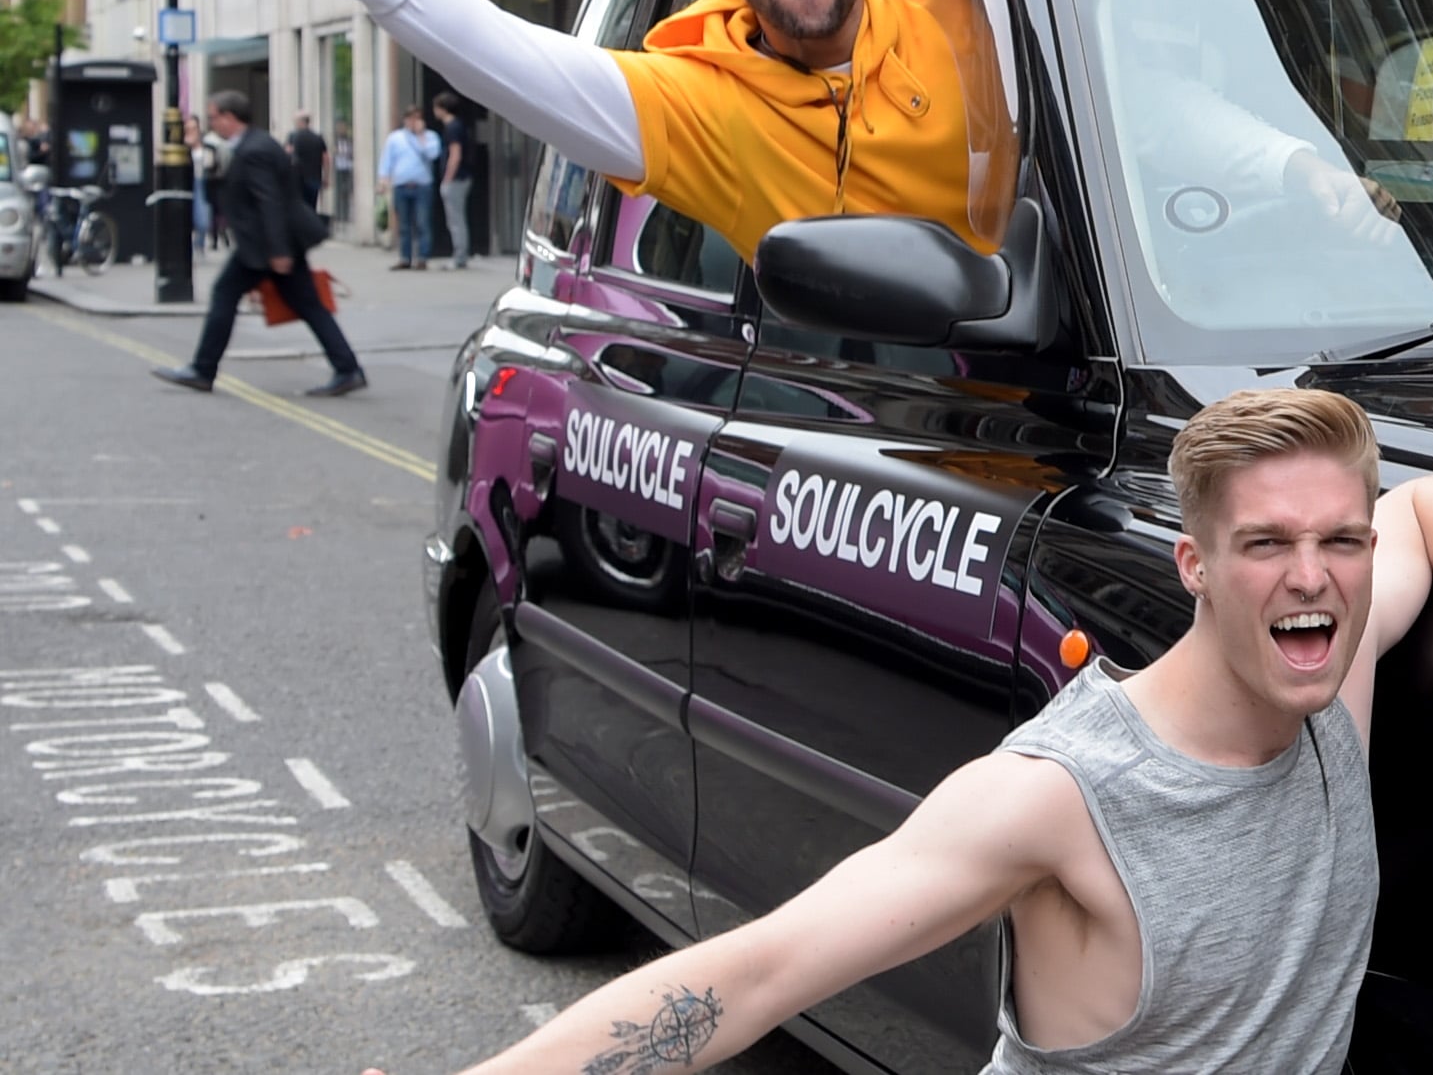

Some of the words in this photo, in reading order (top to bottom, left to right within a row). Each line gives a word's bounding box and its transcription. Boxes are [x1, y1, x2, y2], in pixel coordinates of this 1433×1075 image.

[564, 408, 694, 510] SOULCYCLE
[770, 469, 1002, 596] SOULCYCLE
[0, 664, 416, 995] MOTORCYCLES
